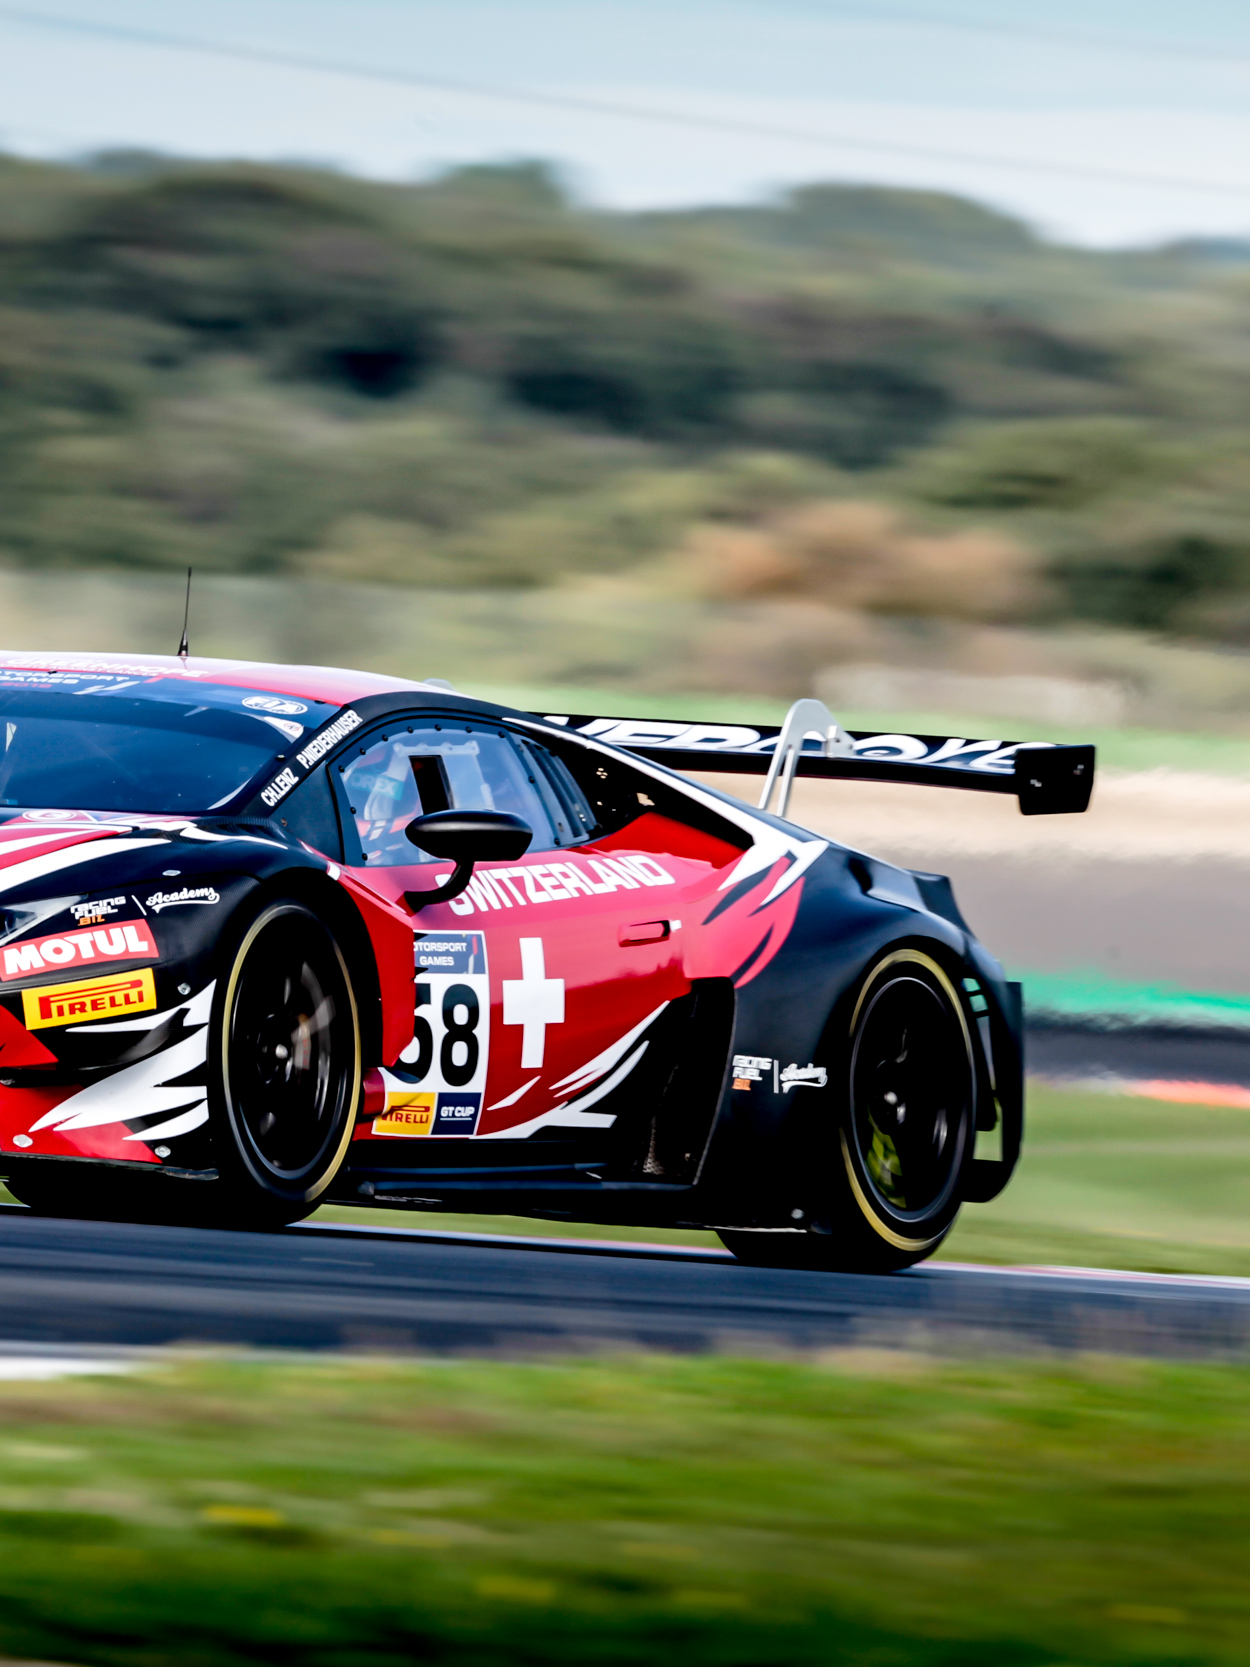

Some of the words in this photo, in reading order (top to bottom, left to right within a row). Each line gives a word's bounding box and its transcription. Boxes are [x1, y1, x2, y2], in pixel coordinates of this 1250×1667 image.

[3, 926, 149, 975] MOTUL
[413, 942, 467, 952] OTORSPORT
[419, 956, 455, 966] GAMES
[38, 979, 144, 1020] PIRELLI
[440, 1106, 454, 1117] GT
[454, 1106, 475, 1117] CUP
